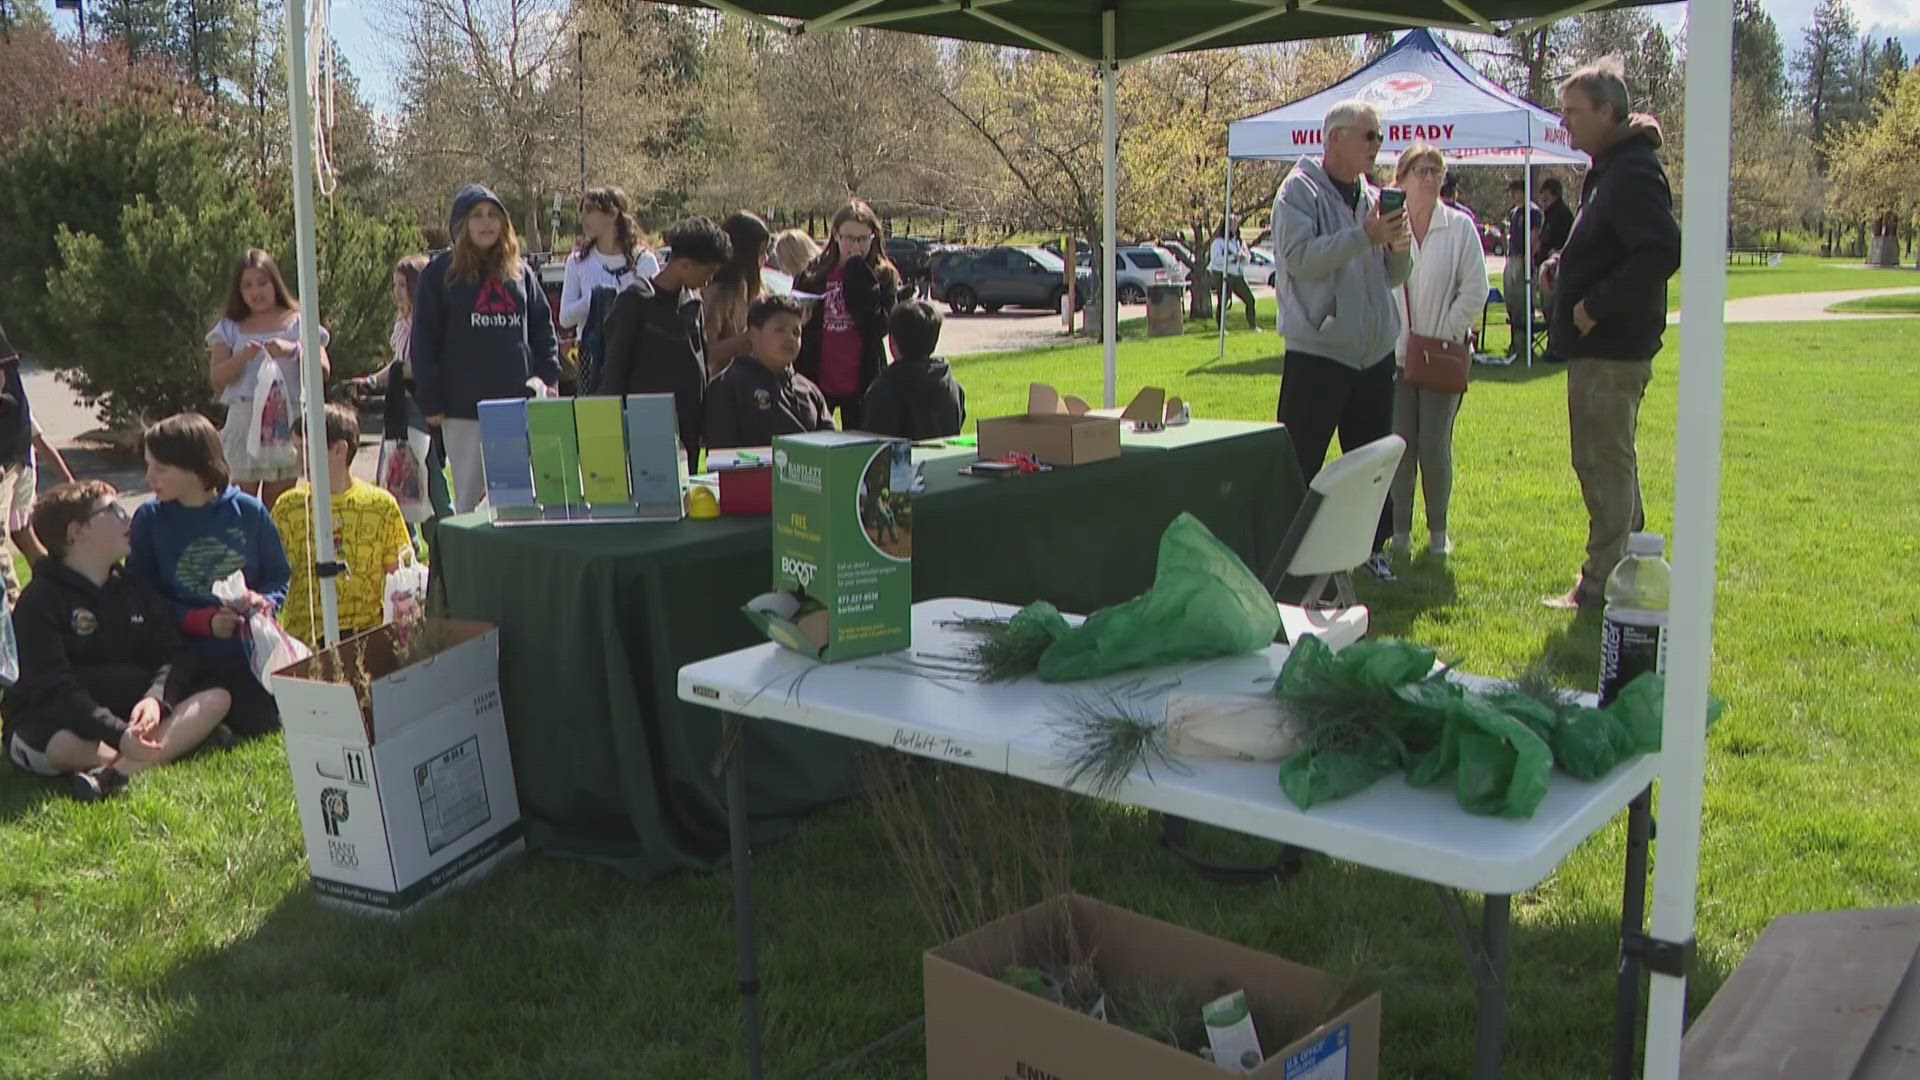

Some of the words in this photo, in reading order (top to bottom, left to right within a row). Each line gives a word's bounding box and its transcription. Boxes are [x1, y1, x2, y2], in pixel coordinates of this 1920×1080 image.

[1389, 124, 1454, 141] READY
[471, 312, 521, 328] Reebok
[788, 463, 822, 477] BARTLETT
[791, 513, 807, 530] FREE
[781, 557, 817, 588] BOOST
[837, 603, 874, 615] bartlett.com
[1606, 622, 1620, 679] water
[940, 737, 974, 758] Tree
[328, 840, 357, 856] PLANT
[330, 851, 359, 868] FOOD
